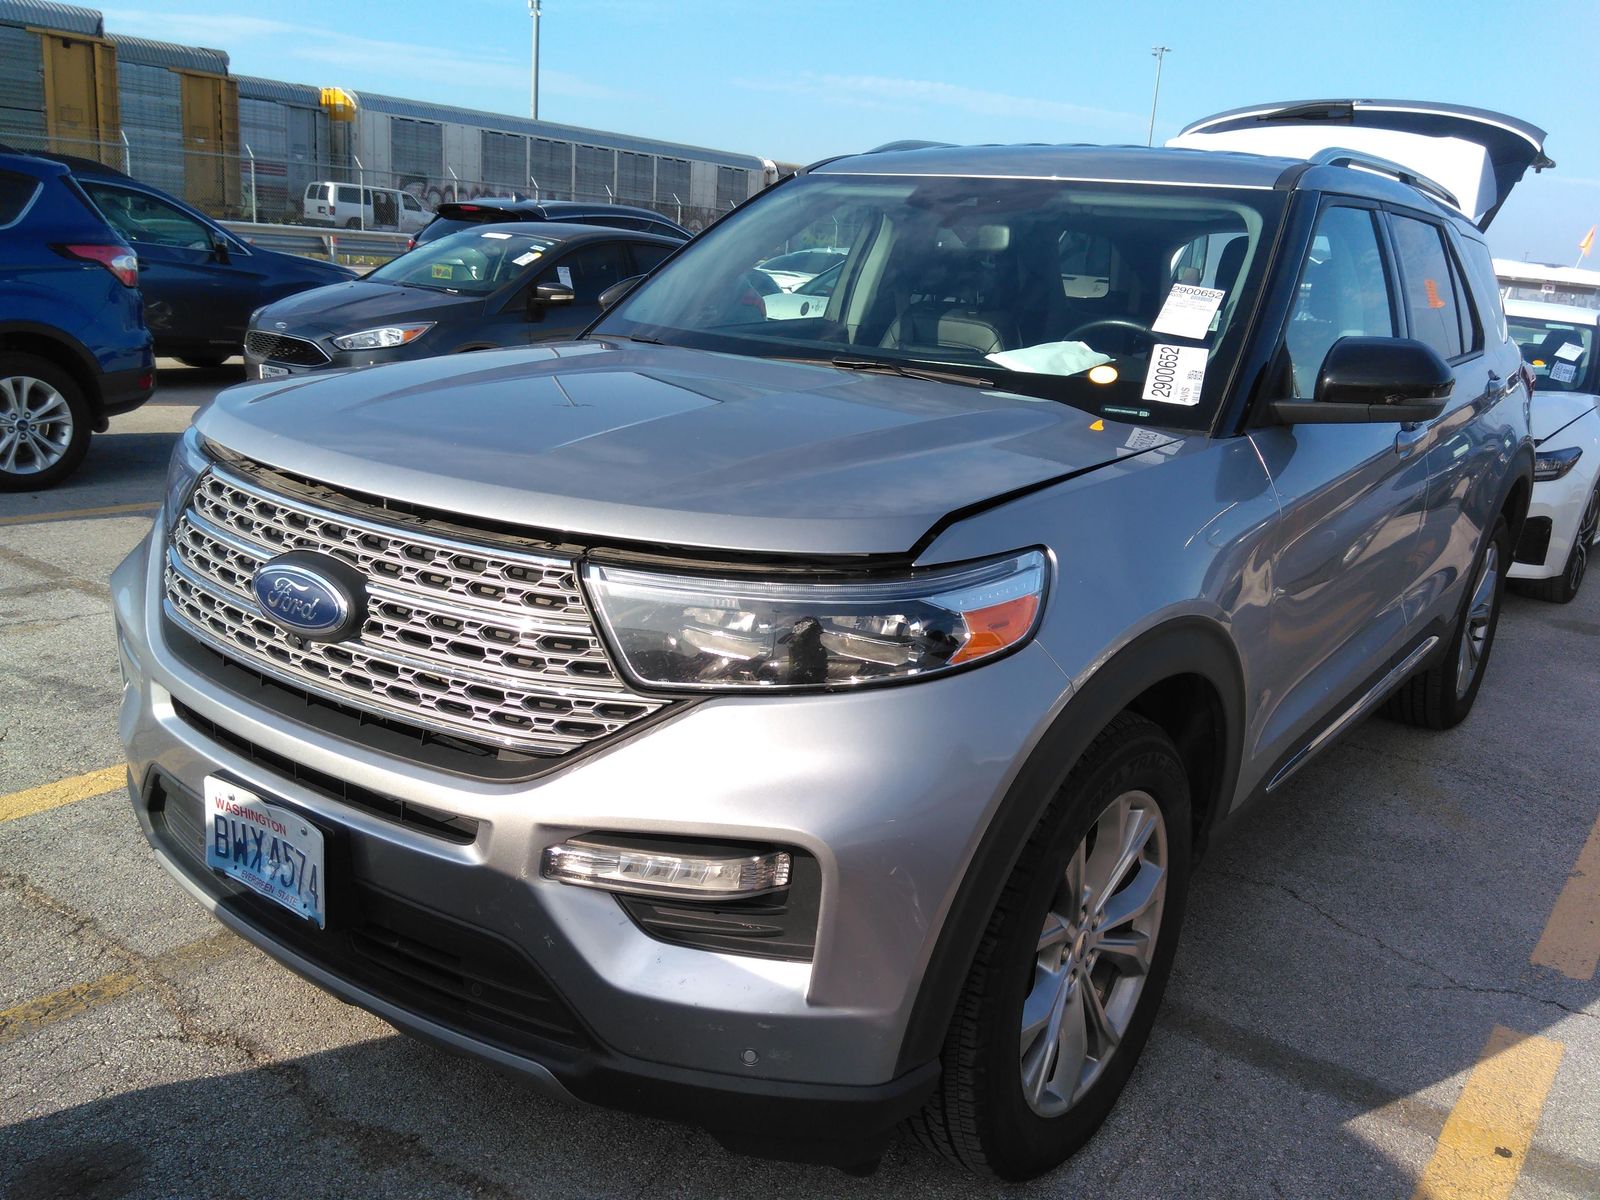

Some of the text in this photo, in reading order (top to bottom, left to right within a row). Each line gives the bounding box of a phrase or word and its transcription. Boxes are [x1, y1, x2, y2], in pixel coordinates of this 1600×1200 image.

[1171, 285, 1224, 299] 2900652
[1151, 346, 1180, 398] 2900652
[1179, 386, 1190, 402] AVIS
[267, 577, 320, 620] Ford
[214, 796, 287, 836] WASHINGTON
[214, 814, 319, 909] BWX4574
[241, 870, 298, 906] EVERGREEN STATE
